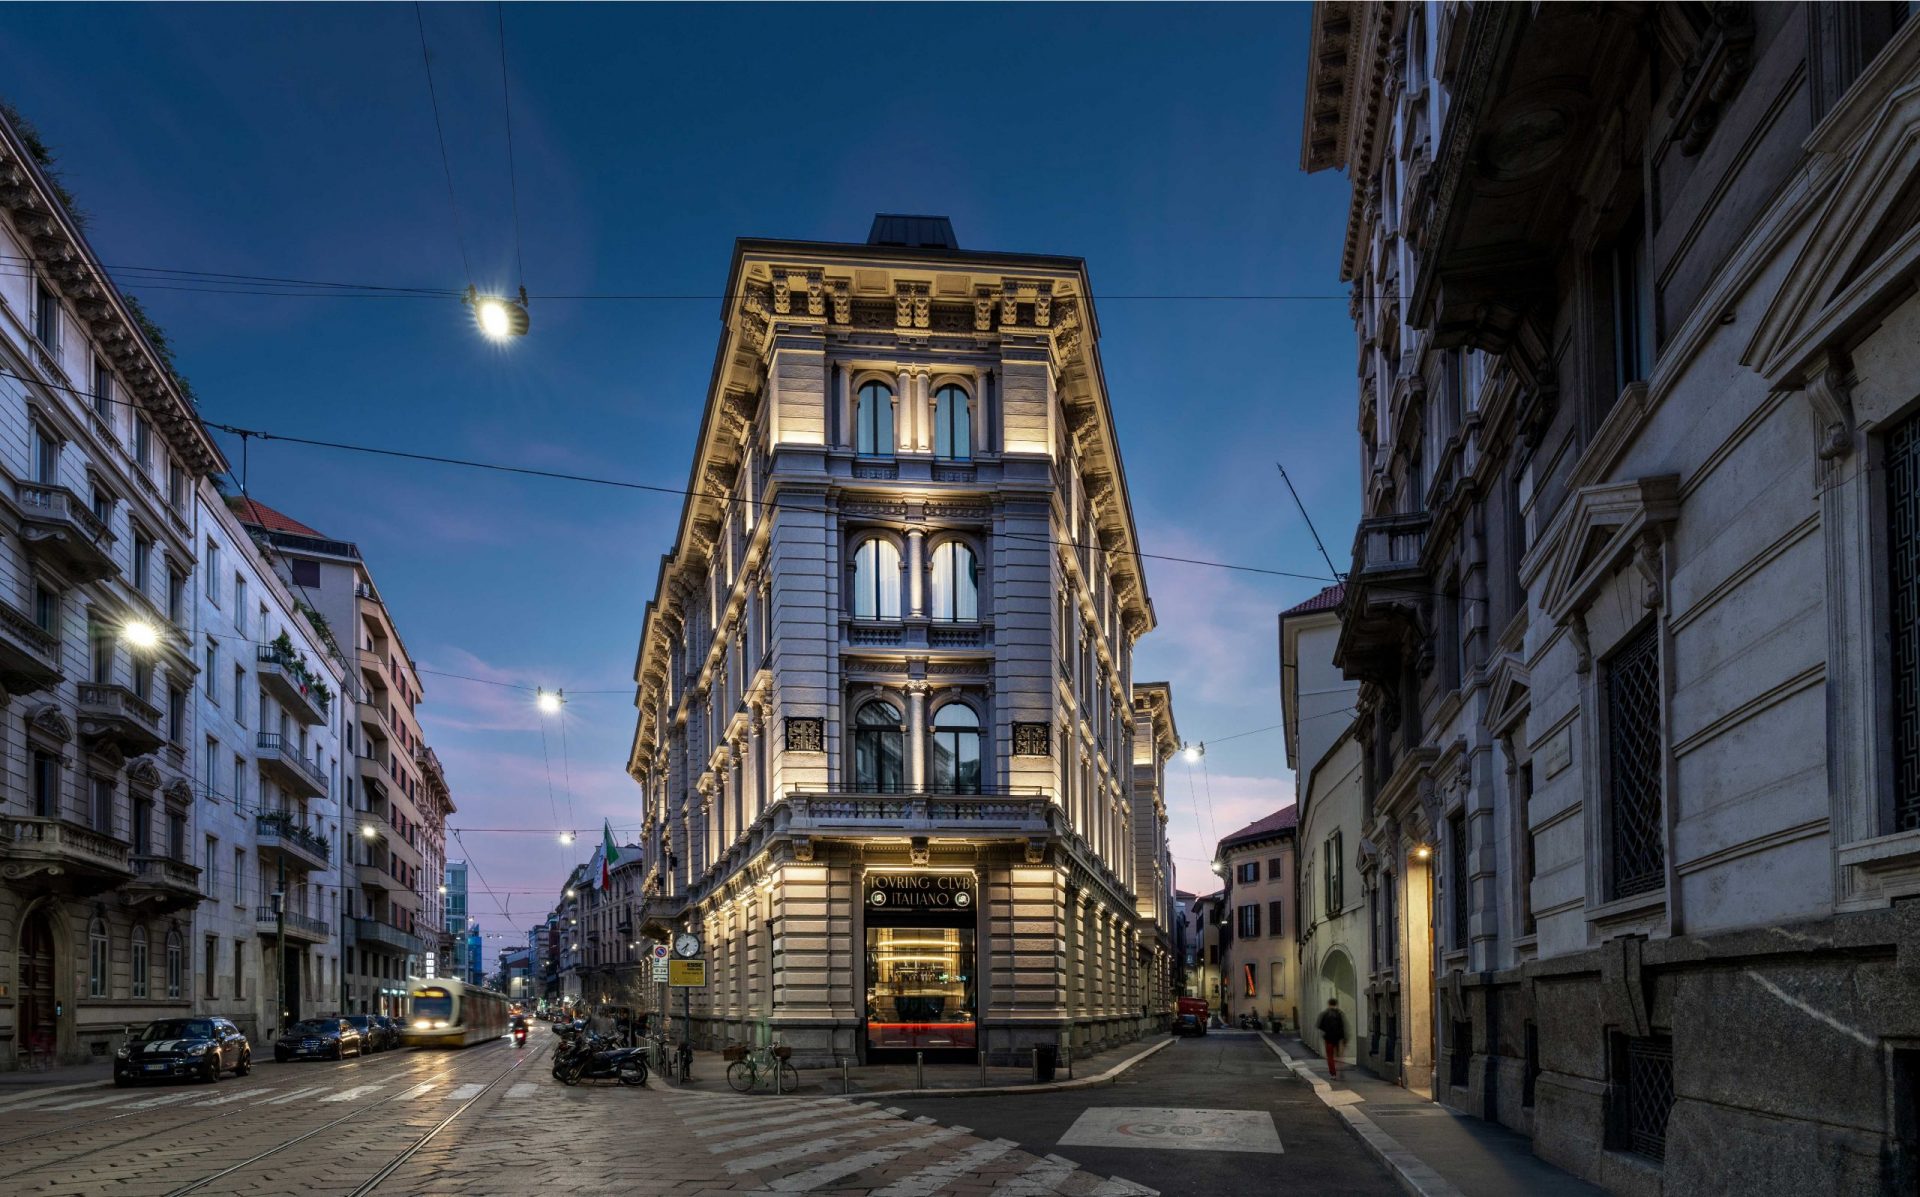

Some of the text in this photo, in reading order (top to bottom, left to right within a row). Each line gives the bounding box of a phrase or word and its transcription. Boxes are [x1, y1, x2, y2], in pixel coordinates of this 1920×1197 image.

[870, 876, 971, 890] TOVRING CLVB
[892, 892, 949, 906] ITALIANO
